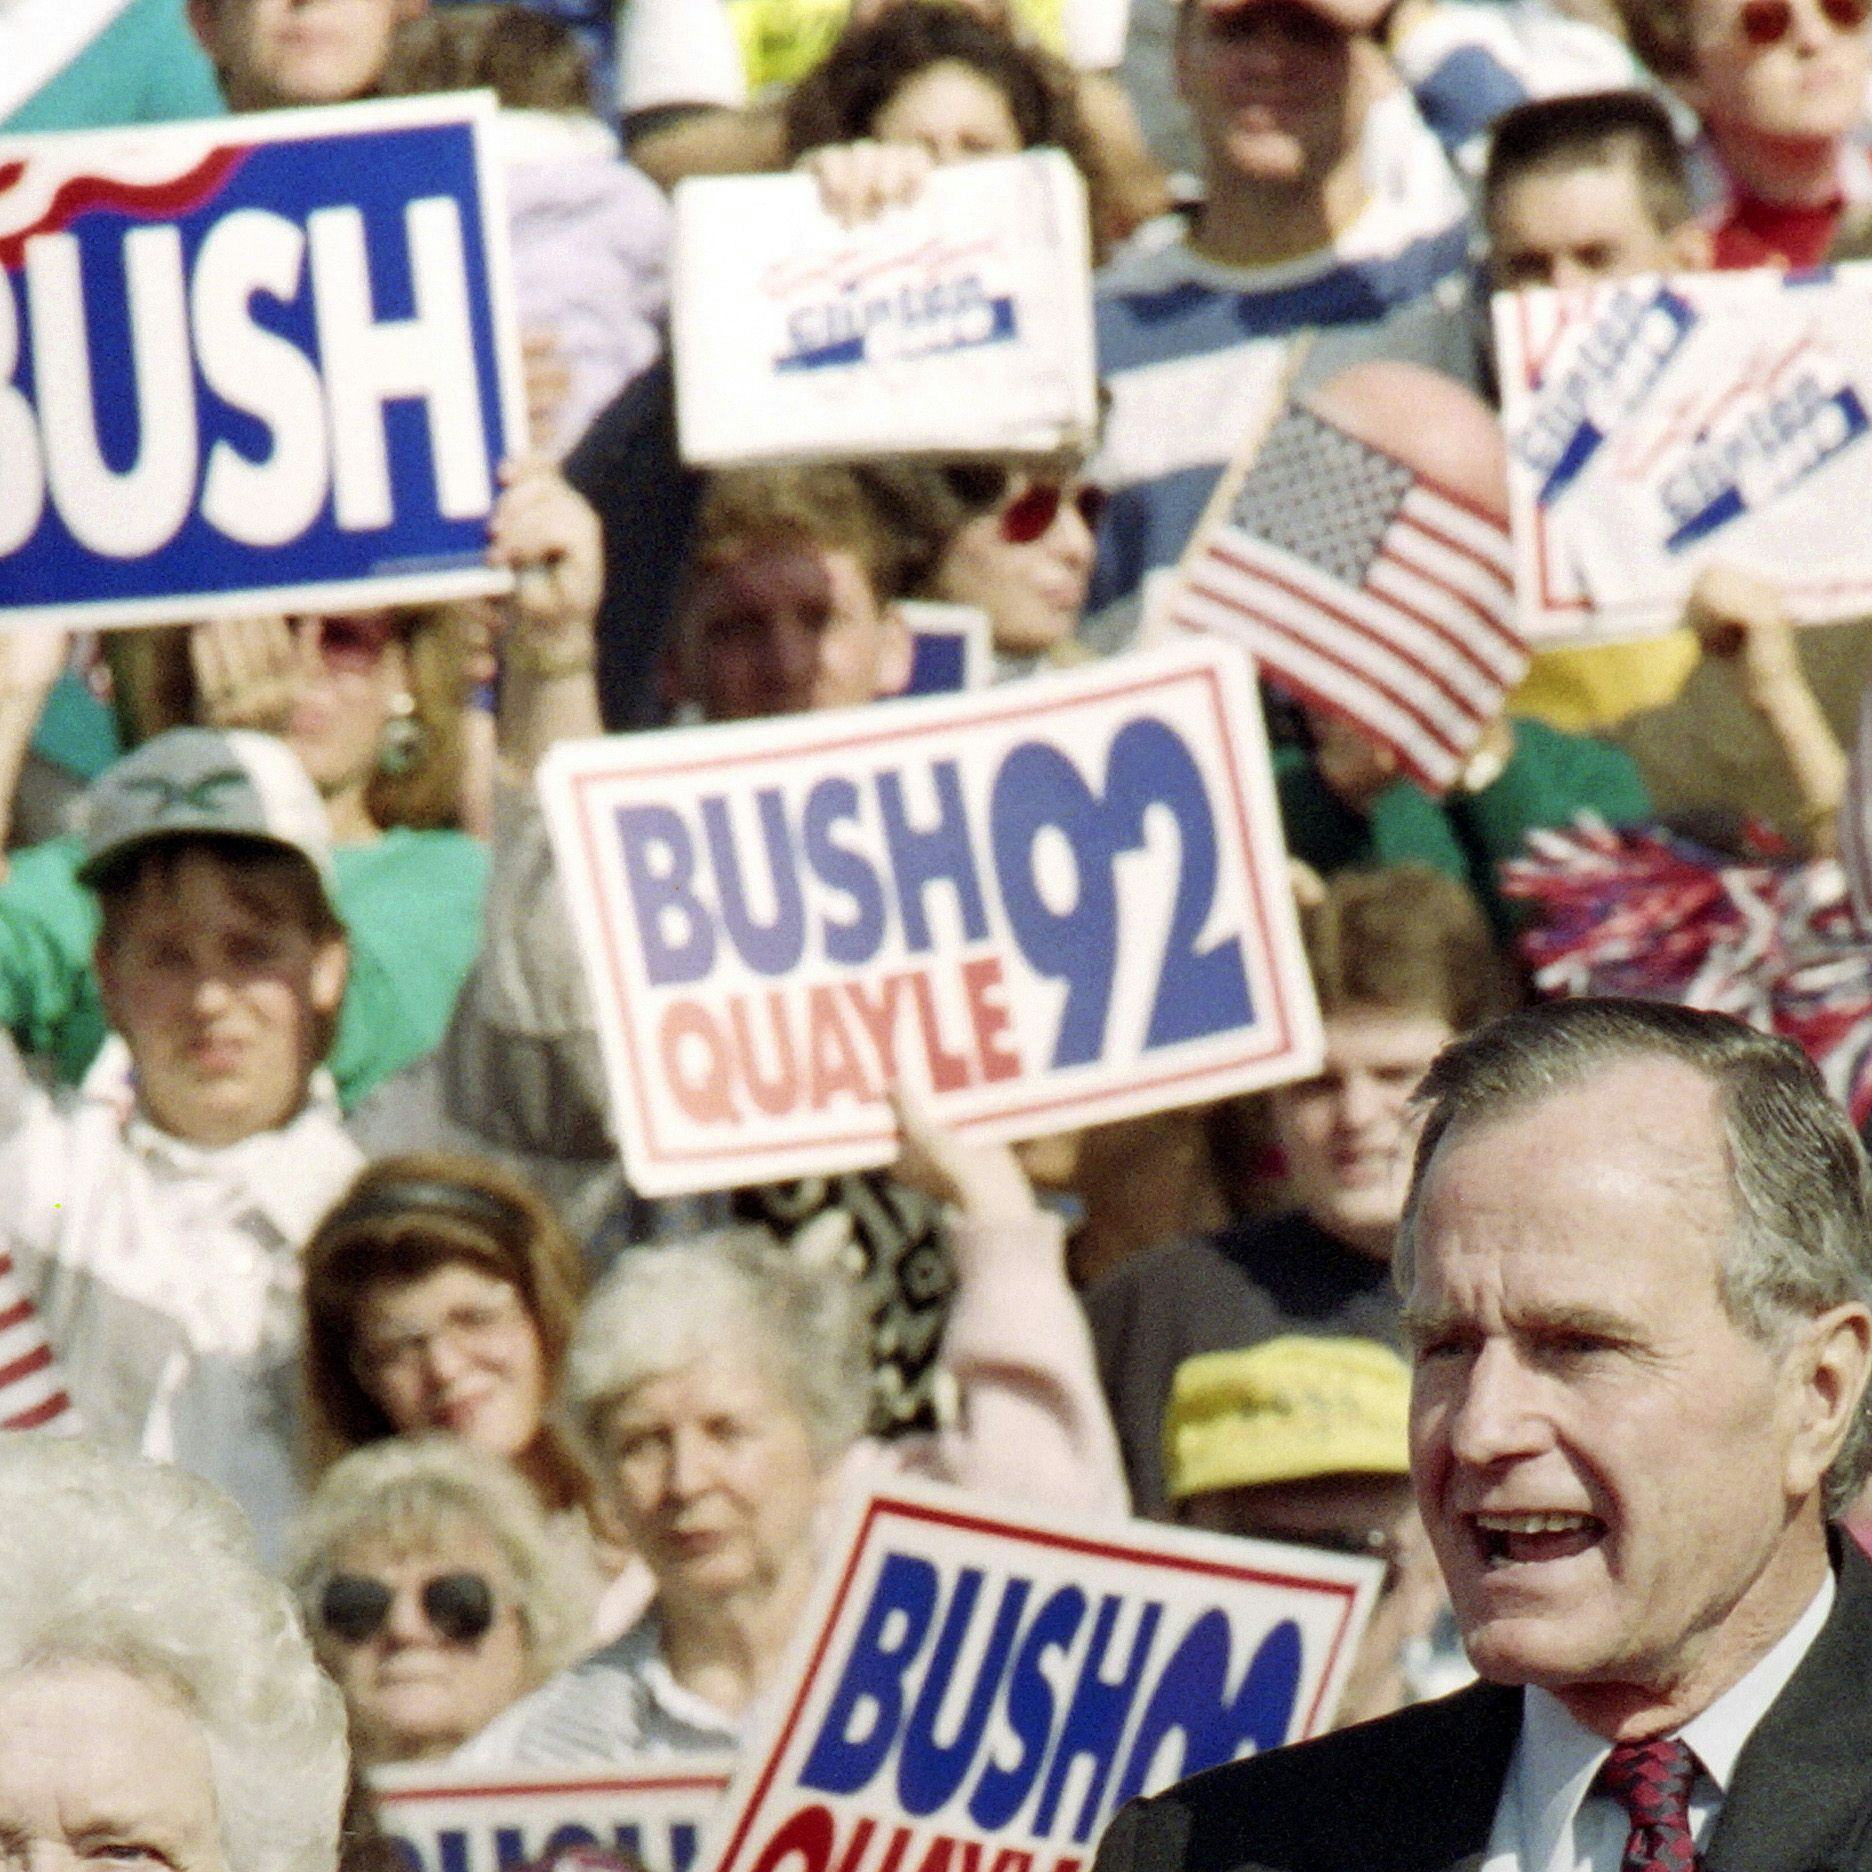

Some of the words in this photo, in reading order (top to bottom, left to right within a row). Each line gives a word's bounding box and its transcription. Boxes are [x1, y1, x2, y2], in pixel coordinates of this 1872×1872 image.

[611, 758, 990, 988] BUSH
[989, 716, 1257, 1074] 92
[656, 956, 1024, 1127] QUAYLE
[795, 1552, 1163, 1844] BUSH
